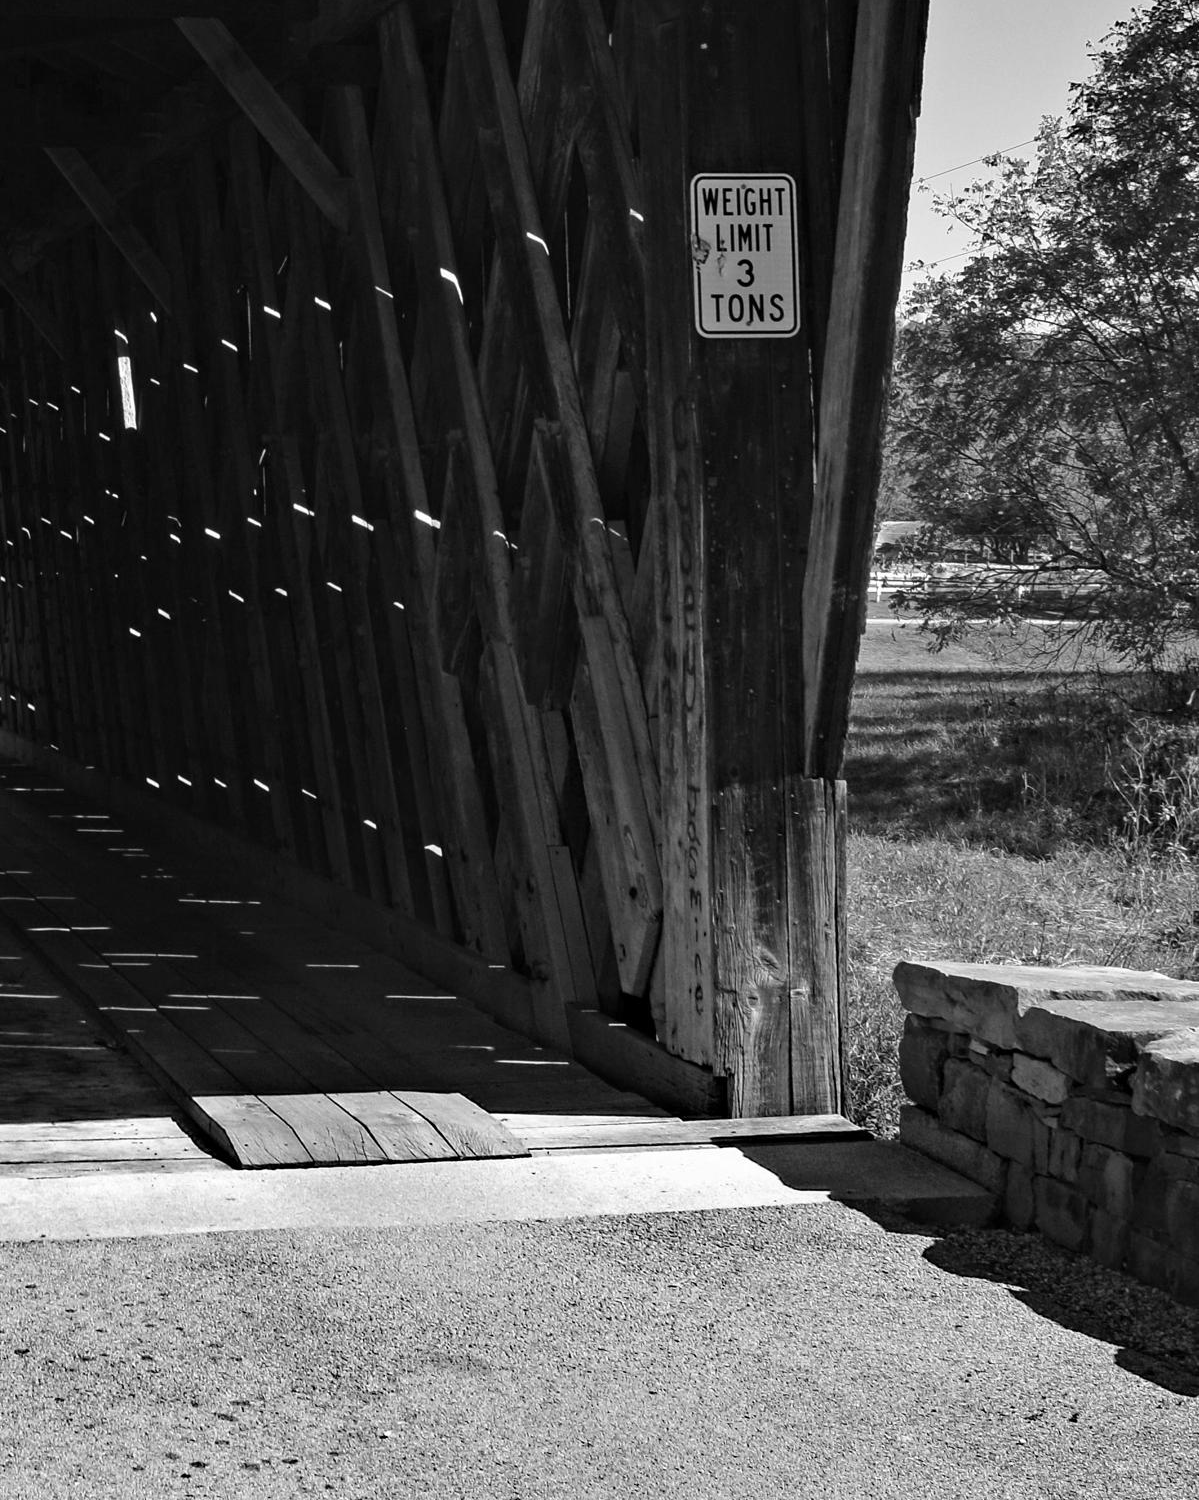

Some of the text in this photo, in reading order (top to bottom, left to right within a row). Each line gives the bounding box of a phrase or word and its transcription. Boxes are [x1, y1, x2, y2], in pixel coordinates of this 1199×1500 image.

[702, 187, 786, 217] WEIGHT
[715, 223, 774, 253] LIMIT
[736, 258, 755, 288] 3
[710, 293, 785, 323] TONS
